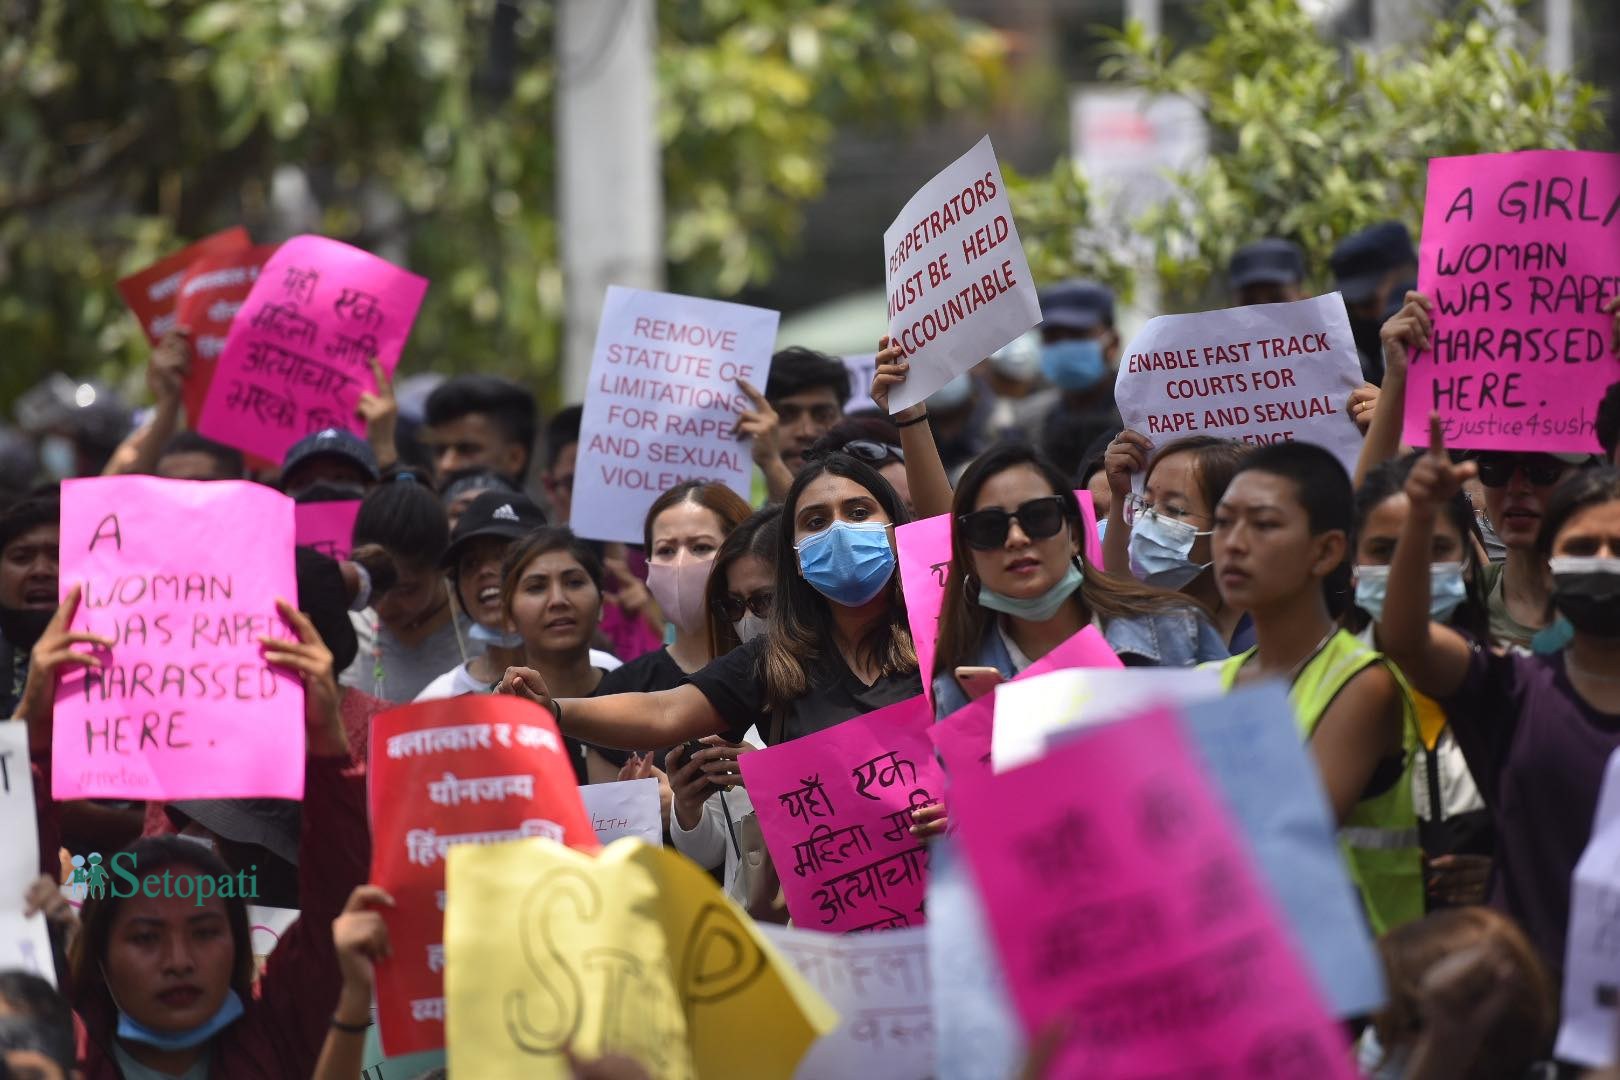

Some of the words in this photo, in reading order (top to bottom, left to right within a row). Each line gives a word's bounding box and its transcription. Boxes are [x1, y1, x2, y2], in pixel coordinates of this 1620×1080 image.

[1445, 186, 1473, 223] A
[889, 171, 997, 281] PERPETRATORS
[928, 253, 951, 289] BE
[962, 215, 1009, 265] HELD
[1436, 241, 1567, 277] WOMAN
[891, 260, 1017, 364] ACCOUNTABLE
[1436, 280, 1512, 317] WAS
[1528, 274, 1620, 315] RAPE
[633, 317, 737, 351] REMOVE
[1128, 348, 1199, 373] ENABLE
[1203, 342, 1252, 366] FAST
[1257, 332, 1331, 359] TRACK
[606, 344, 712, 378] STATUTE
[719, 362, 753, 382] OF
[600, 374, 748, 415] LIMITATIONS
[1166, 373, 1247, 400] COURTS
[1251, 368, 1296, 391] FOR
[608, 404, 658, 432] FOR
[665, 415, 734, 441] RAPE
[1147, 412, 1198, 434] RAPE
[1204, 406, 1250, 429] AND
[1253, 395, 1337, 424] SEXUAL
[588, 434, 639, 458] AND
[647, 443, 744, 472] SEXUAL
[89, 514, 122, 552] A
[85, 575, 233, 608] WOMAN
[84, 661, 279, 703] HARASSED
[852, 750, 917, 801] एक
[791, 824, 872, 877] महिला
